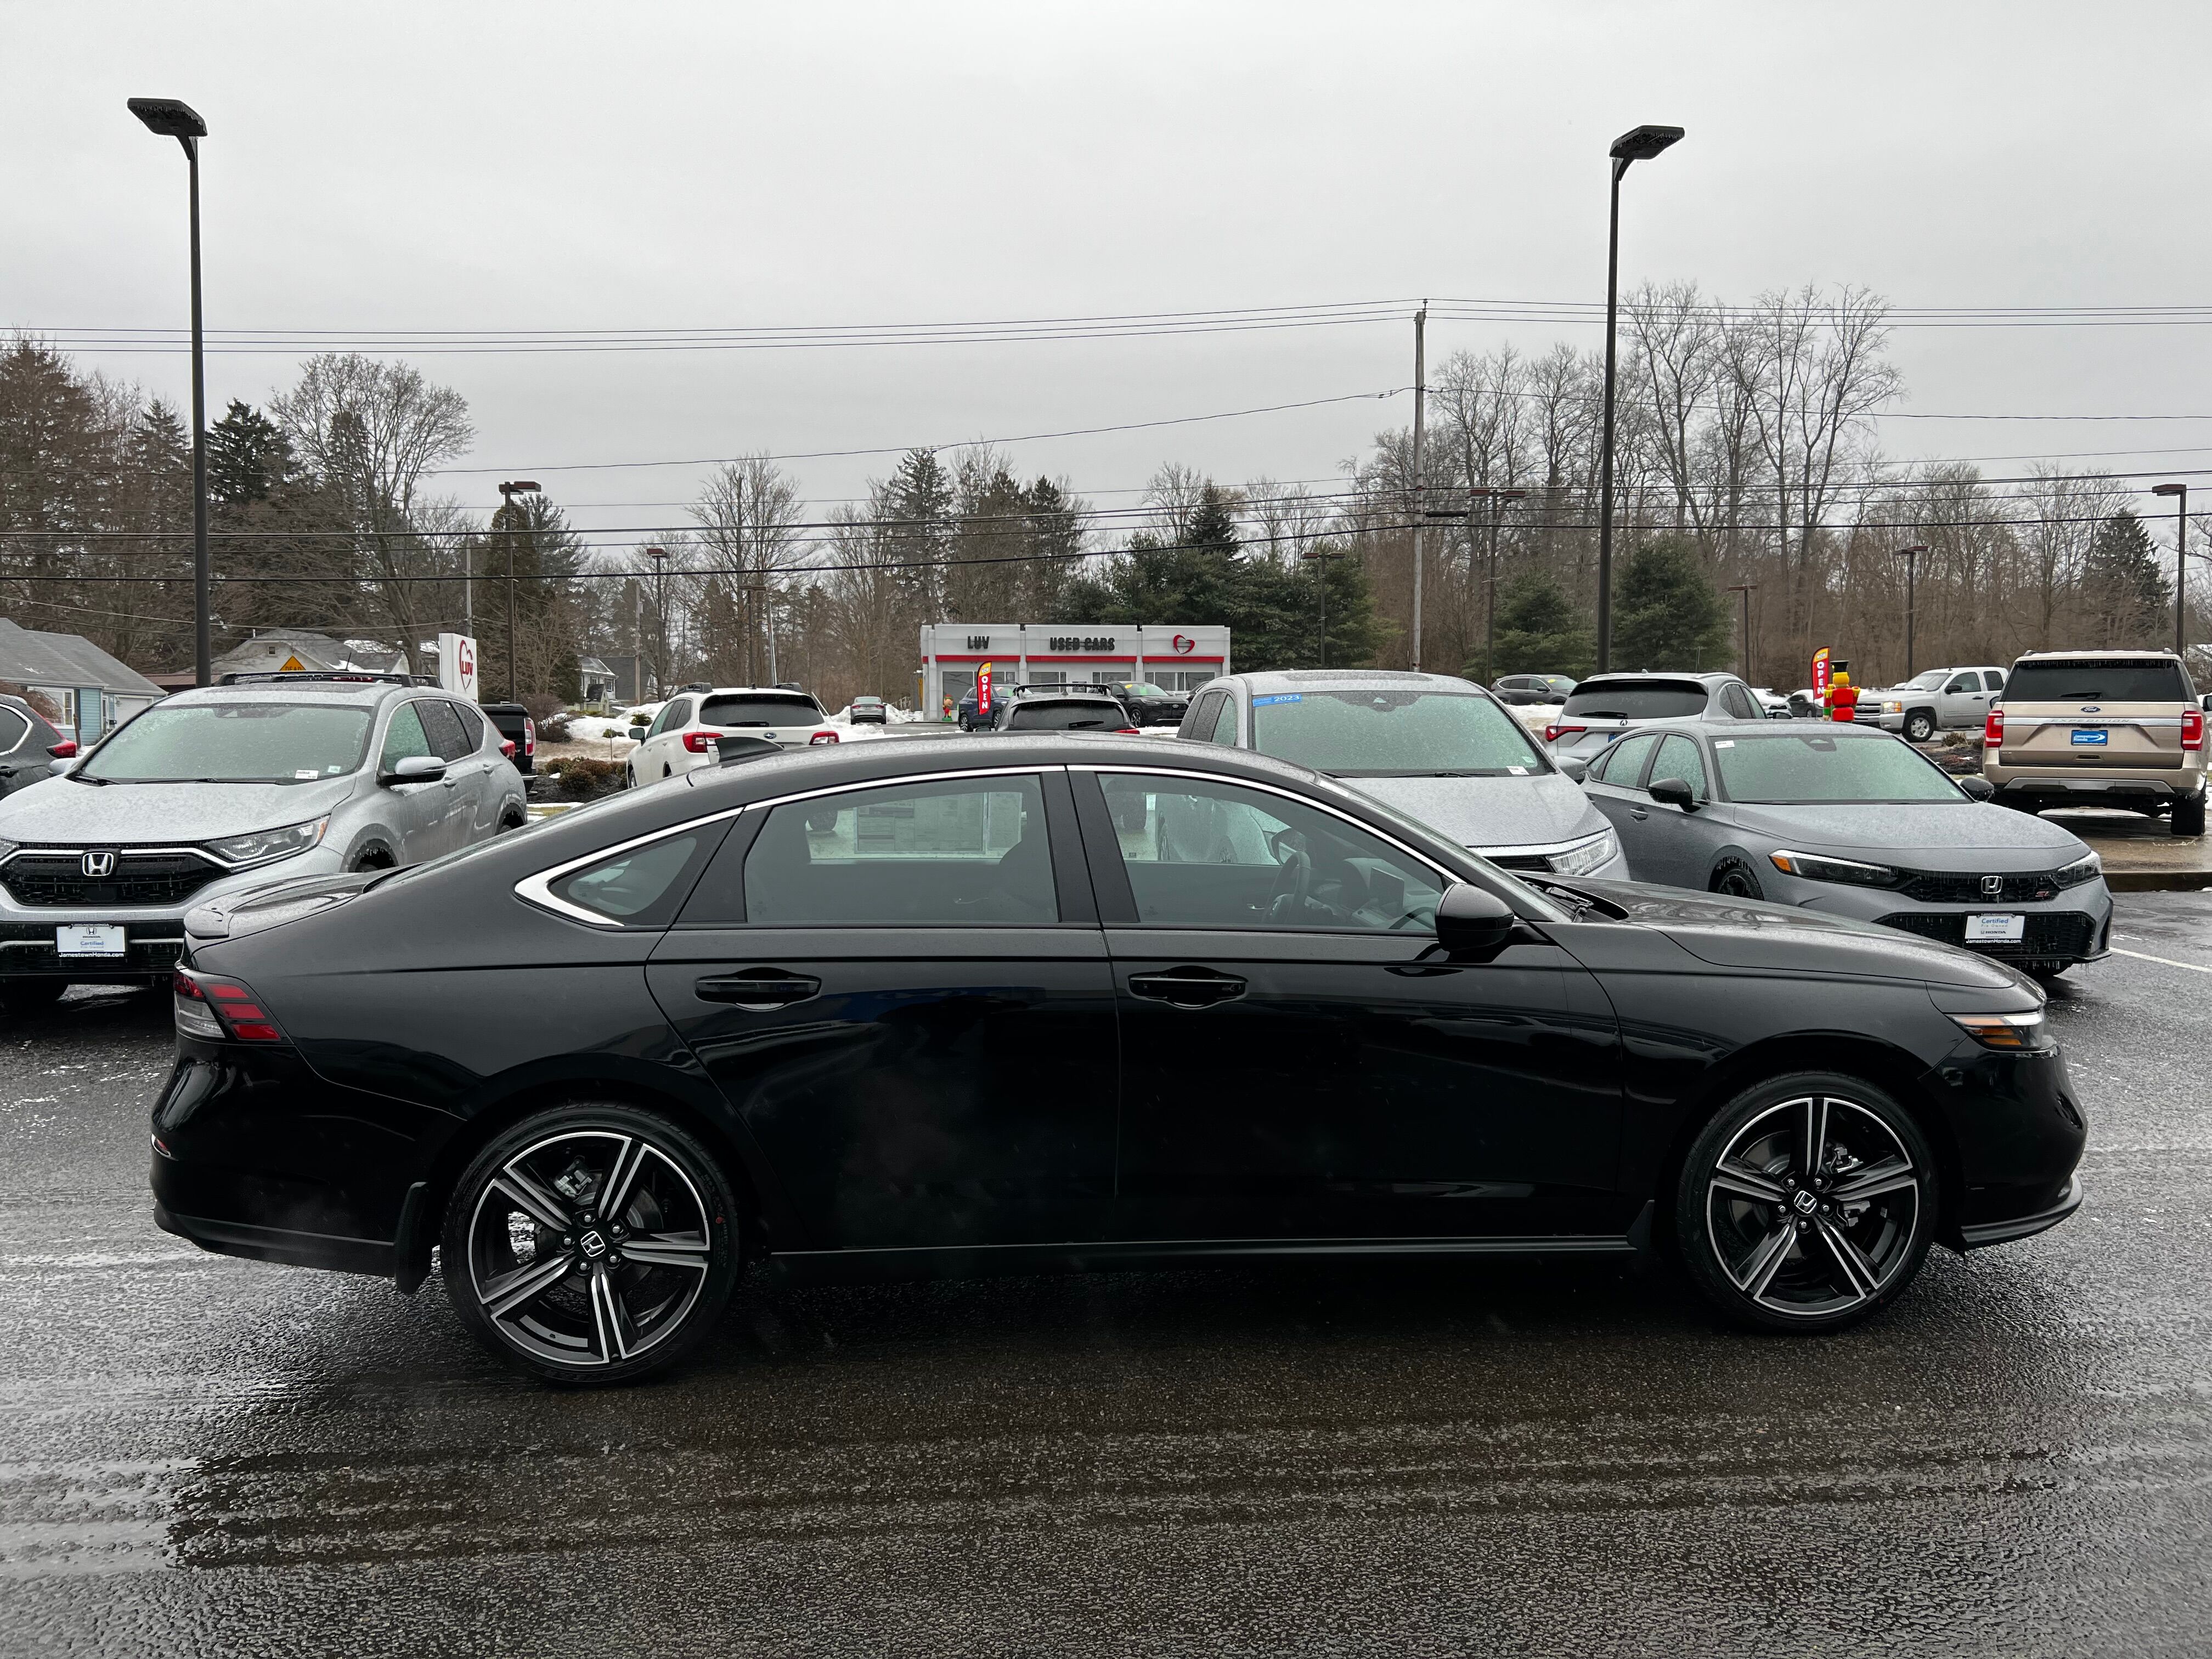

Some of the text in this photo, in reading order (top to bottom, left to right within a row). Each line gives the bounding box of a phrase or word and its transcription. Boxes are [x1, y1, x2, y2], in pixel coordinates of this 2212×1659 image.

[968, 636, 990, 649] LUV
[1049, 637, 1115, 651] USED CARS
[461, 661, 473, 676] LUV
[1816, 662, 1825, 695] OPEN
